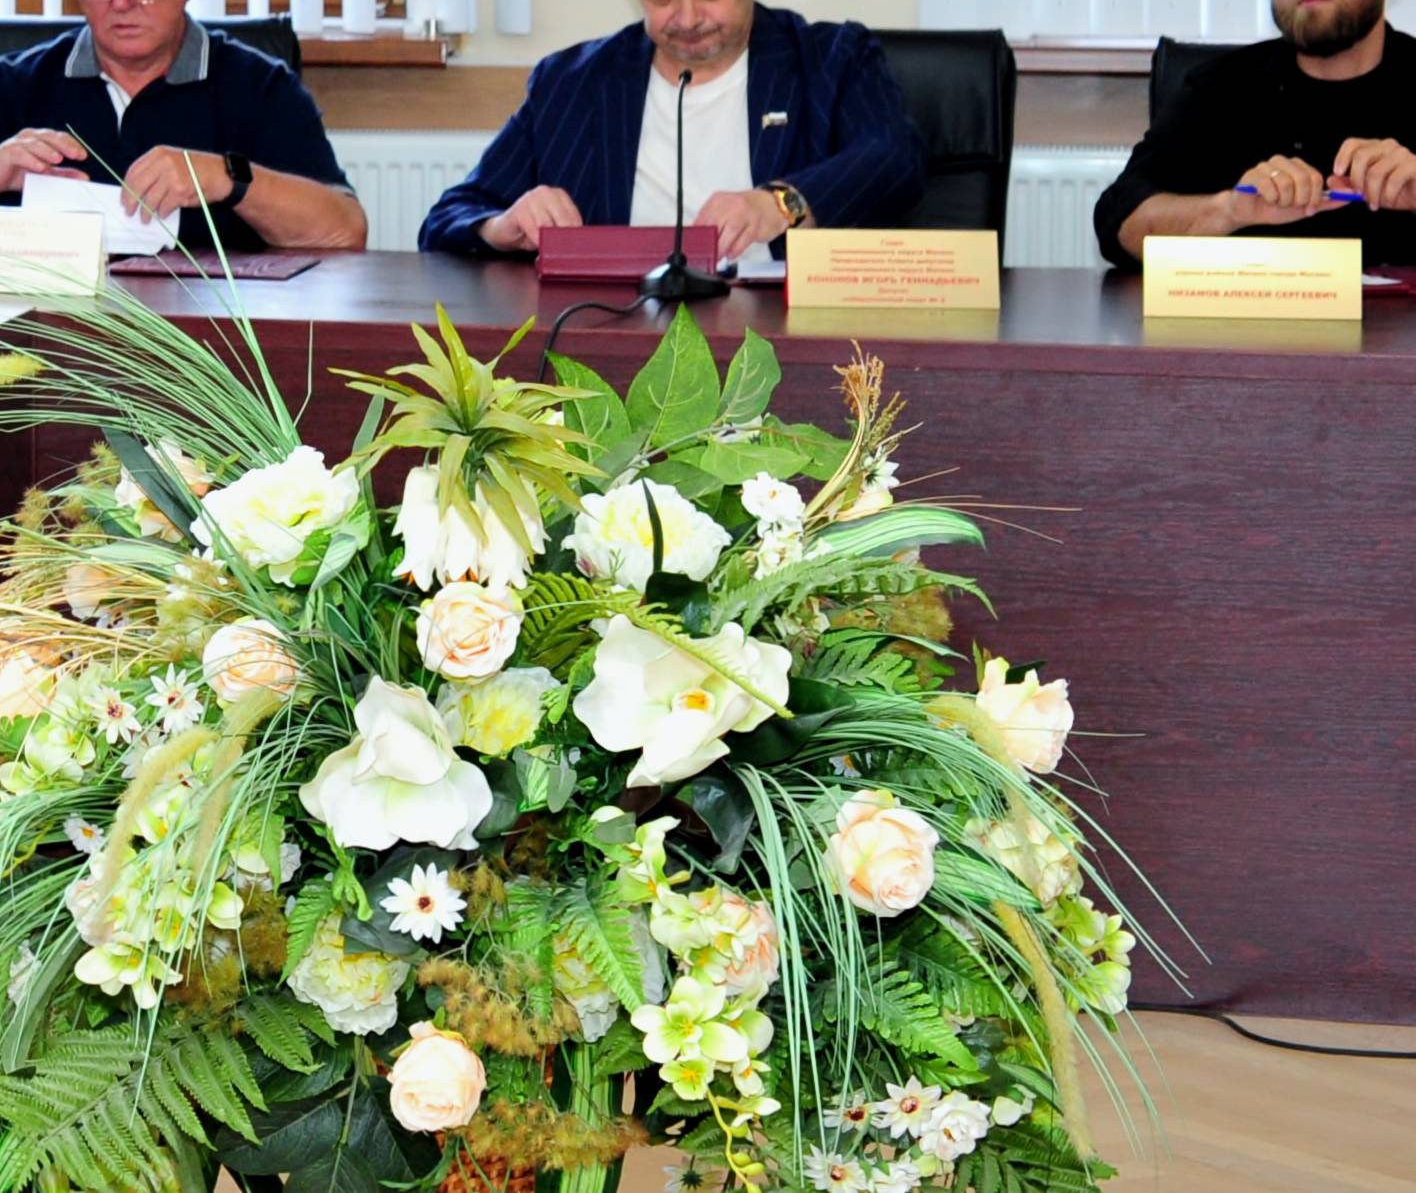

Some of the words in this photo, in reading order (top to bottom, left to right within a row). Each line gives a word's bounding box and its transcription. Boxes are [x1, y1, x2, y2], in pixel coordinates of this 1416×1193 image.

[862, 275, 896, 285] ИГОРЬ
[900, 275, 981, 286] ГЕННАДЬЕВИЧ
[1168, 288, 1220, 297] НИЗАМОВ
[1223, 289, 1272, 298] АЛЕКСЕЙ
[1275, 290, 1338, 299] СЕРГЕЕВИЧ
